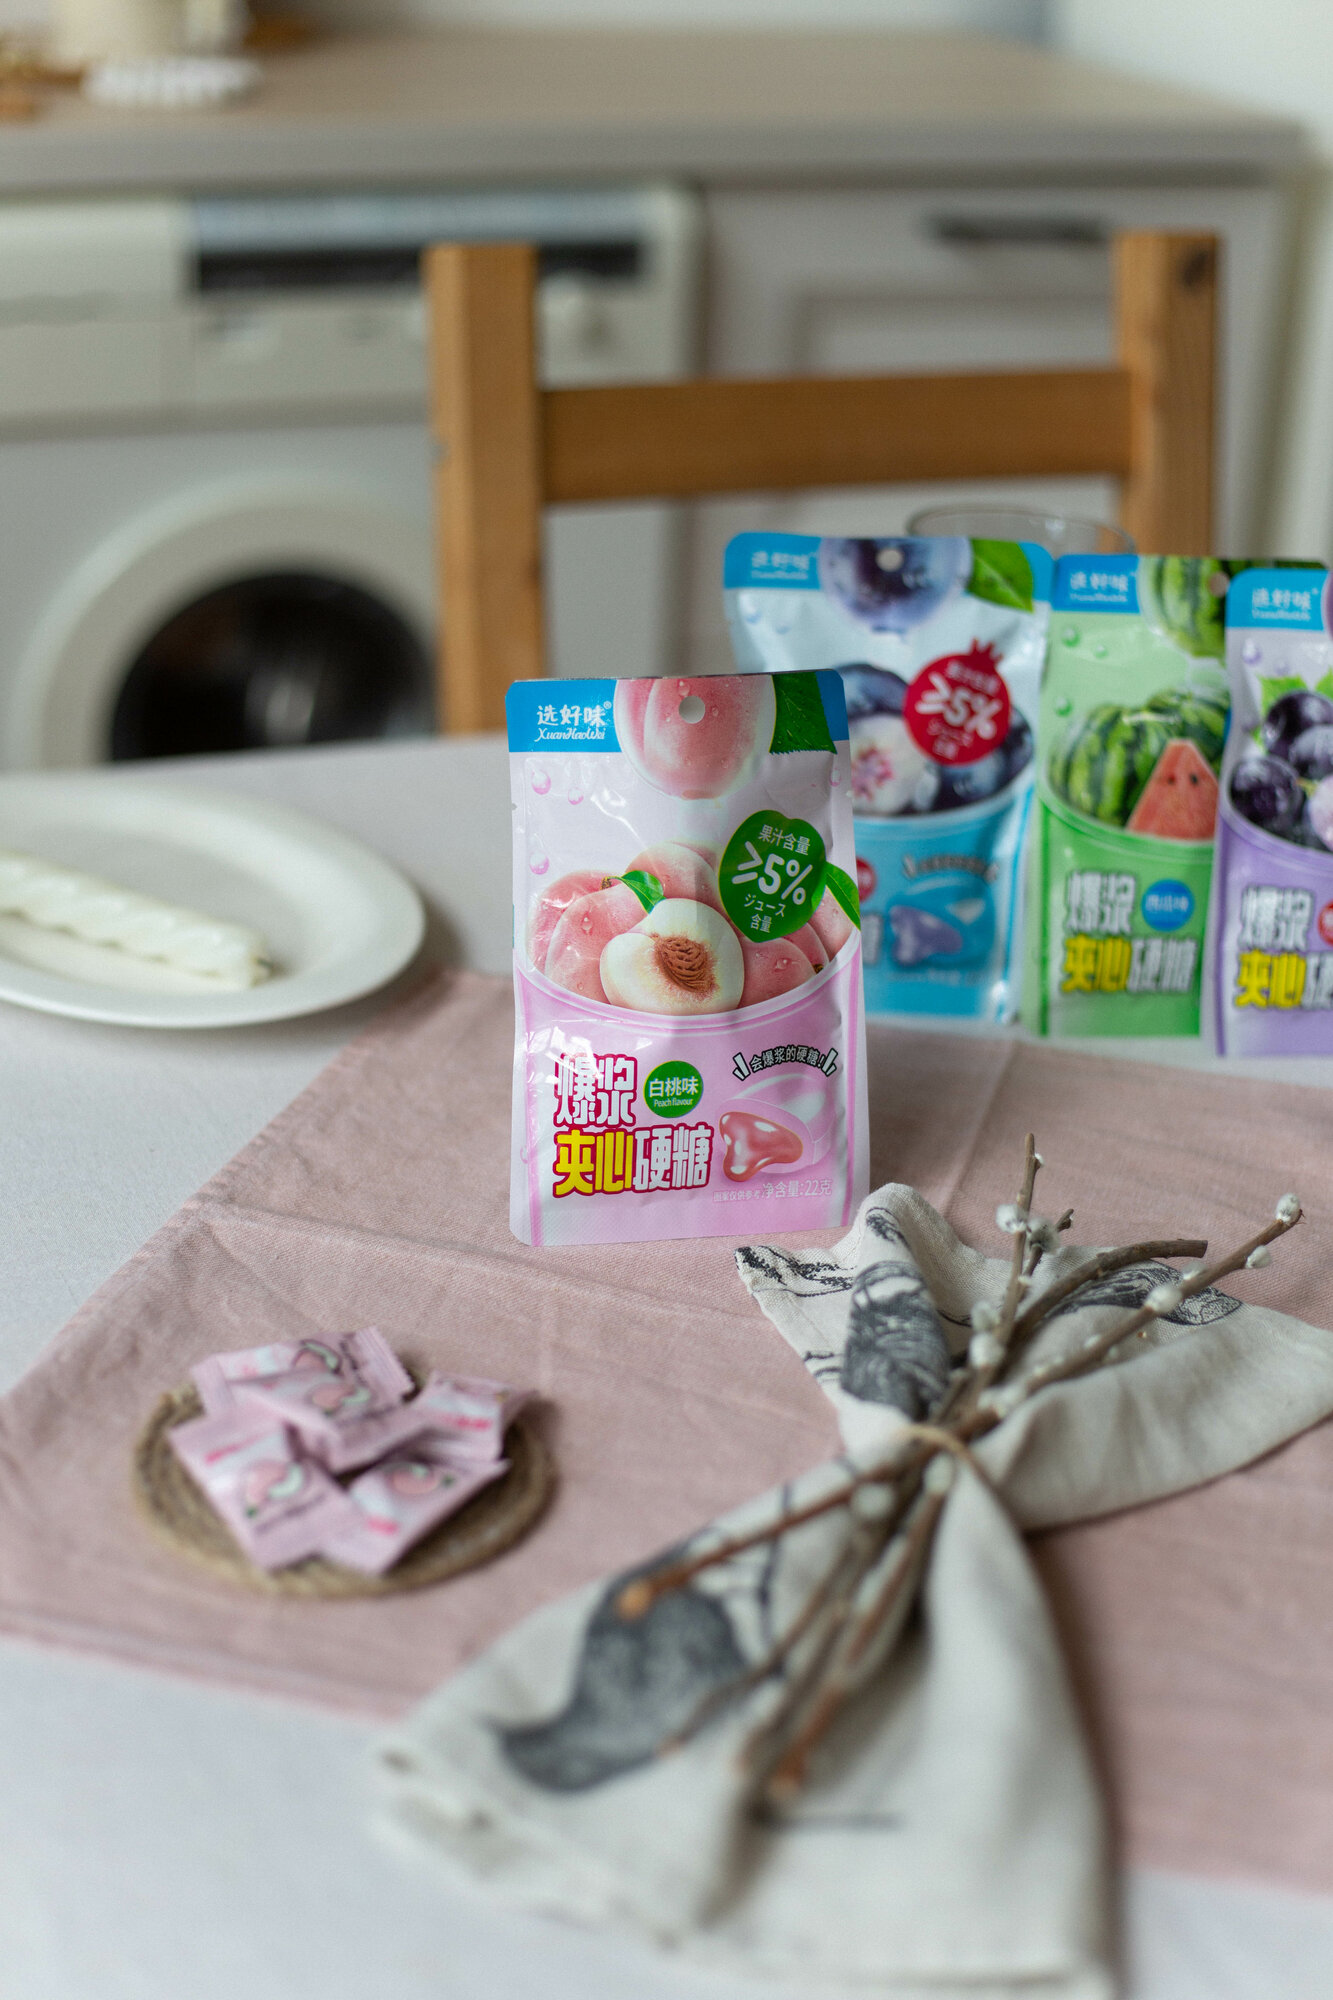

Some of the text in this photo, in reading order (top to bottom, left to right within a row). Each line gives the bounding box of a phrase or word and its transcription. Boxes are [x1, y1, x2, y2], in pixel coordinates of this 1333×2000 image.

[758, 824, 811, 855] 果汁含量
[744, 893, 786, 918] ジュース
[750, 914, 772, 933] 含量
[649, 1076, 699, 1097] 白桃味
[654, 1098, 672, 1107] Peach
[554, 1124, 713, 1196] 夹心硬糖
